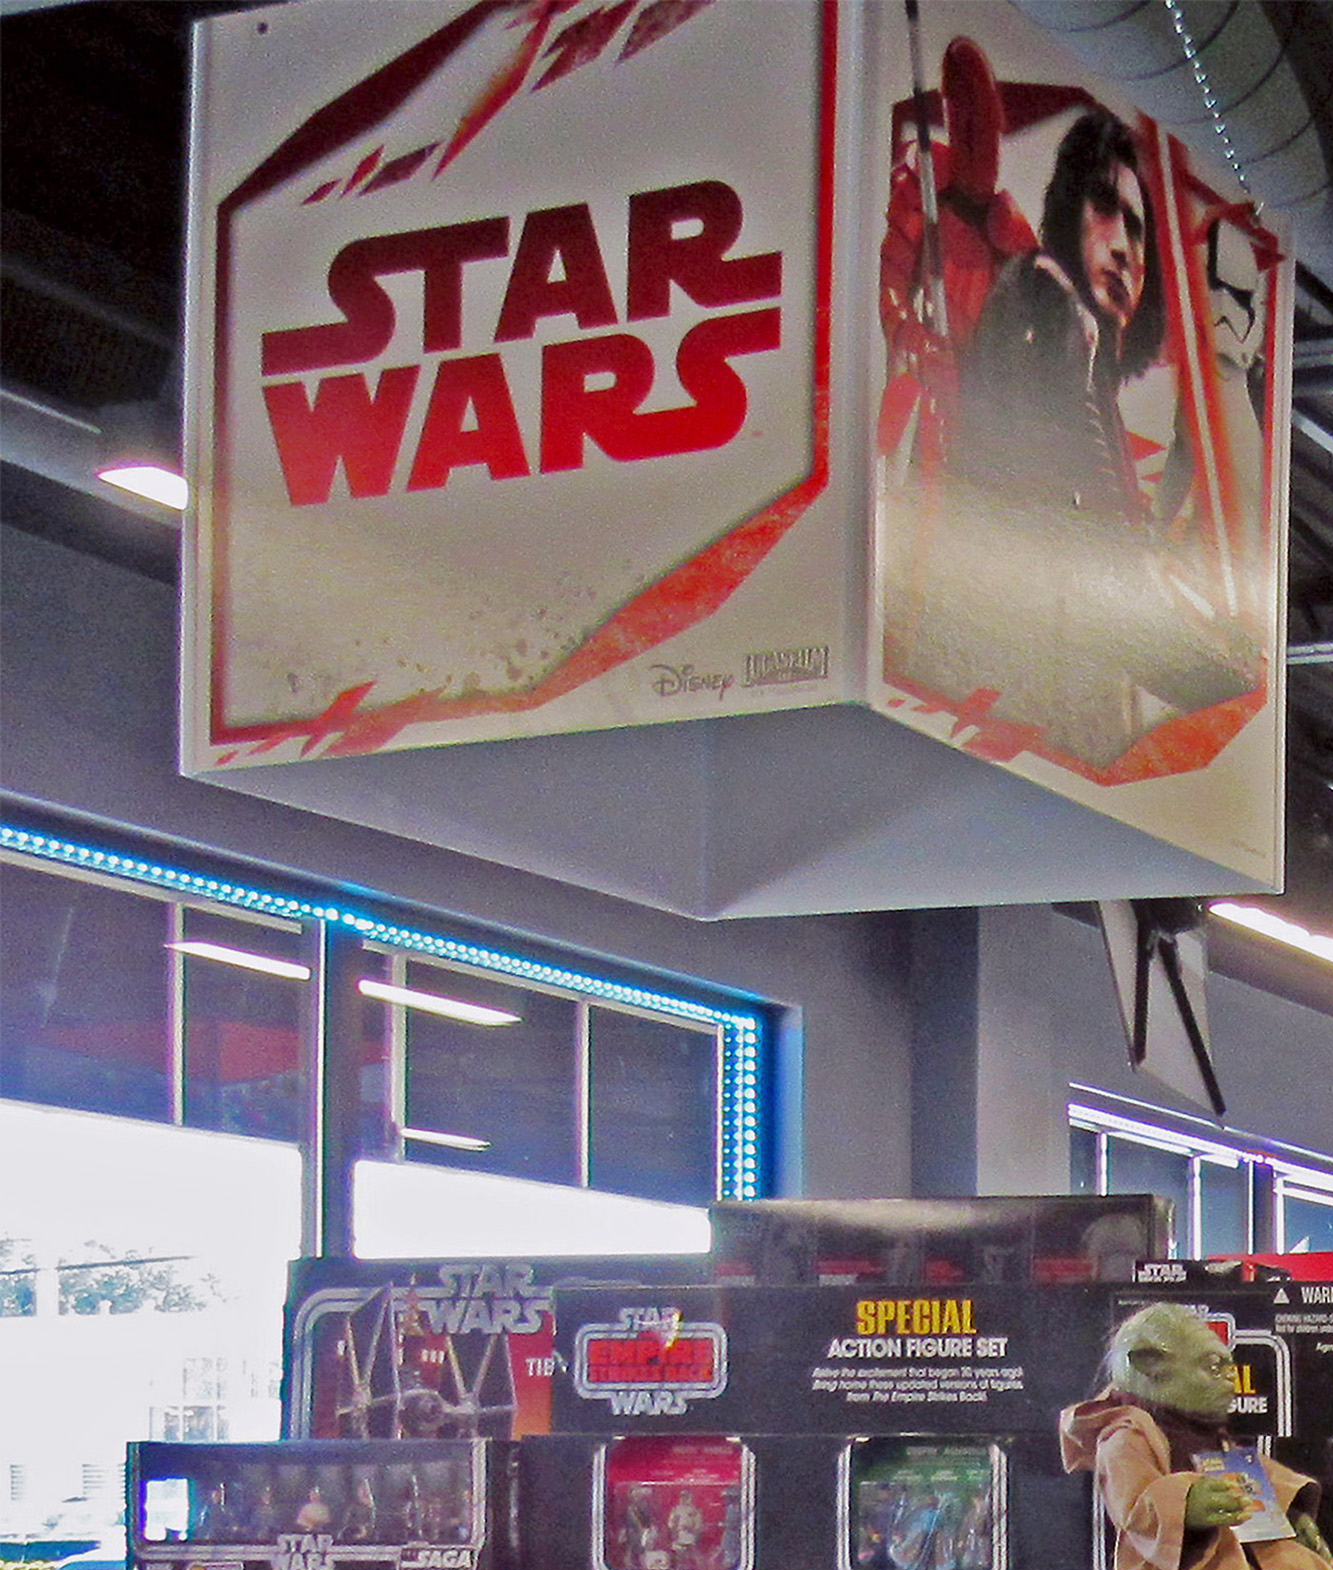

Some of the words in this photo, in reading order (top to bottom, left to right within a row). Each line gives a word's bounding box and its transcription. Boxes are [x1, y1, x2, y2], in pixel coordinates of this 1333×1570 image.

[261, 179, 783, 374] STAR
[261, 306, 783, 507] WARS
[650, 663, 735, 702] Disney
[438, 1263, 535, 1299] STAR
[1142, 1263, 1186, 1276] STAR
[421, 1300, 546, 1335] WARS
[856, 1299, 978, 1336] SPECIAL
[827, 1337, 901, 1358] ACTION
[906, 1337, 973, 1358] FIGURE
[976, 1337, 1009, 1358] SET
[610, 1391, 688, 1416] WARS
[1227, 1397, 1269, 1414] GURE
[276, 1533, 335, 1553] STAR
[402, 1550, 475, 1569] SAGA
